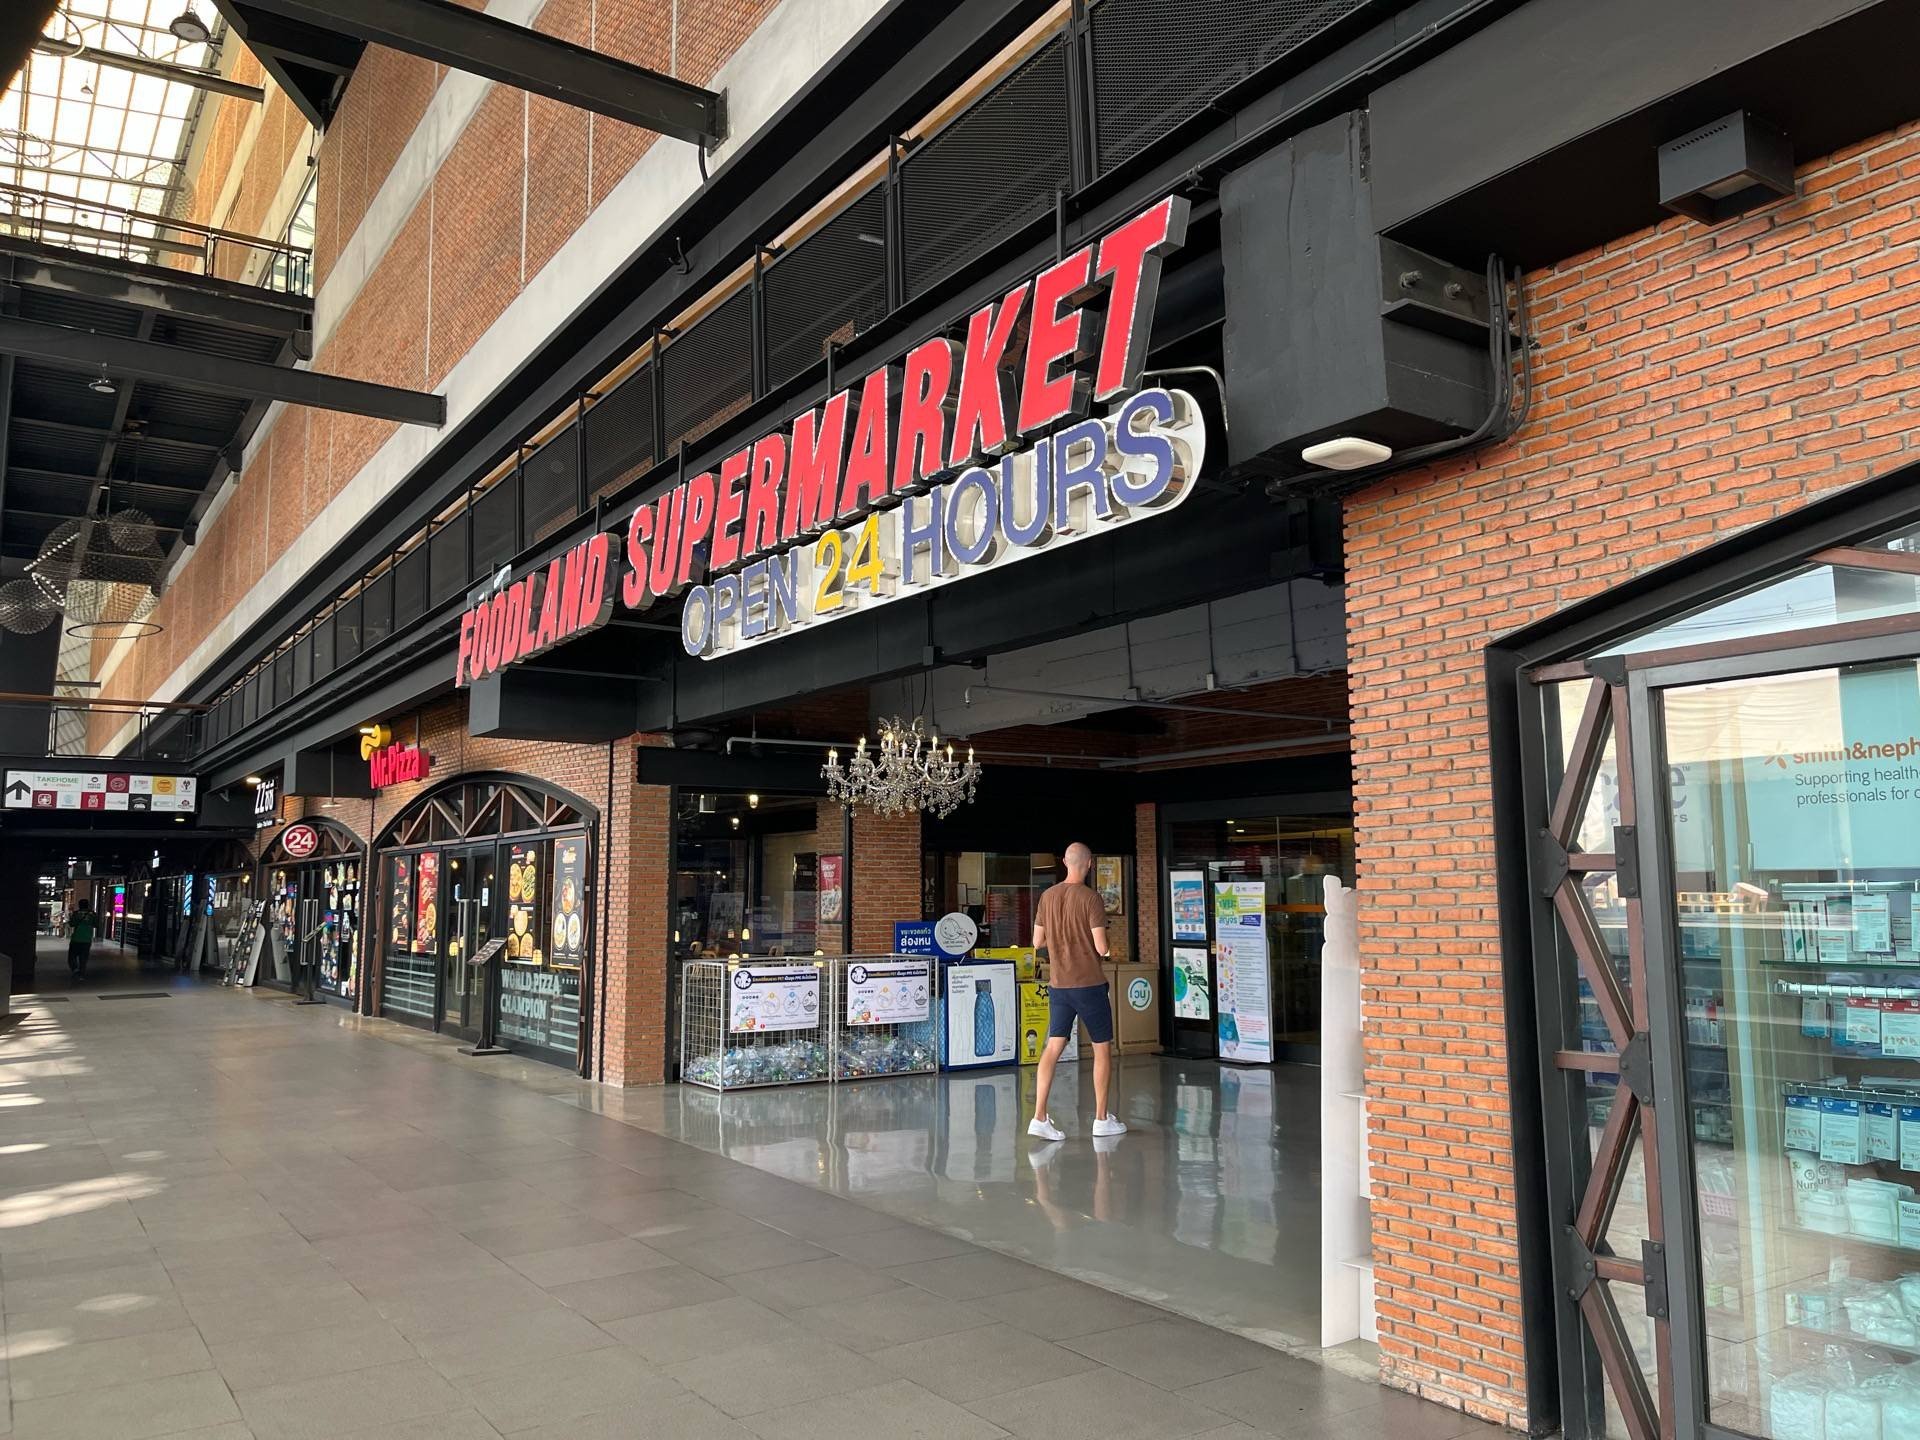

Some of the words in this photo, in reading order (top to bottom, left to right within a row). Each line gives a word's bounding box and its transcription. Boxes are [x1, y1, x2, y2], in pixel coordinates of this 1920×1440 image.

[455, 532, 611, 688] FOODLAND
[623, 195, 1176, 609] SUPERMARKET
[682, 547, 799, 657] OPEN
[814, 512, 885, 615] 24
[902, 387, 1176, 585] HOURS
[37, 776, 79, 784] TAKEHOME
[1795, 769, 1871, 788] Supporting
[1874, 764, 1920, 781] health
[1797, 787, 1887, 808] professionals
[1890, 786, 1910, 801] for
[287, 831, 315, 849] 24
[900, 935, 931, 947] ล่องหน
[501, 968, 532, 991] WORLD
[533, 972, 561, 996] PIZZA
[500, 993, 547, 1020] CHAMPION
